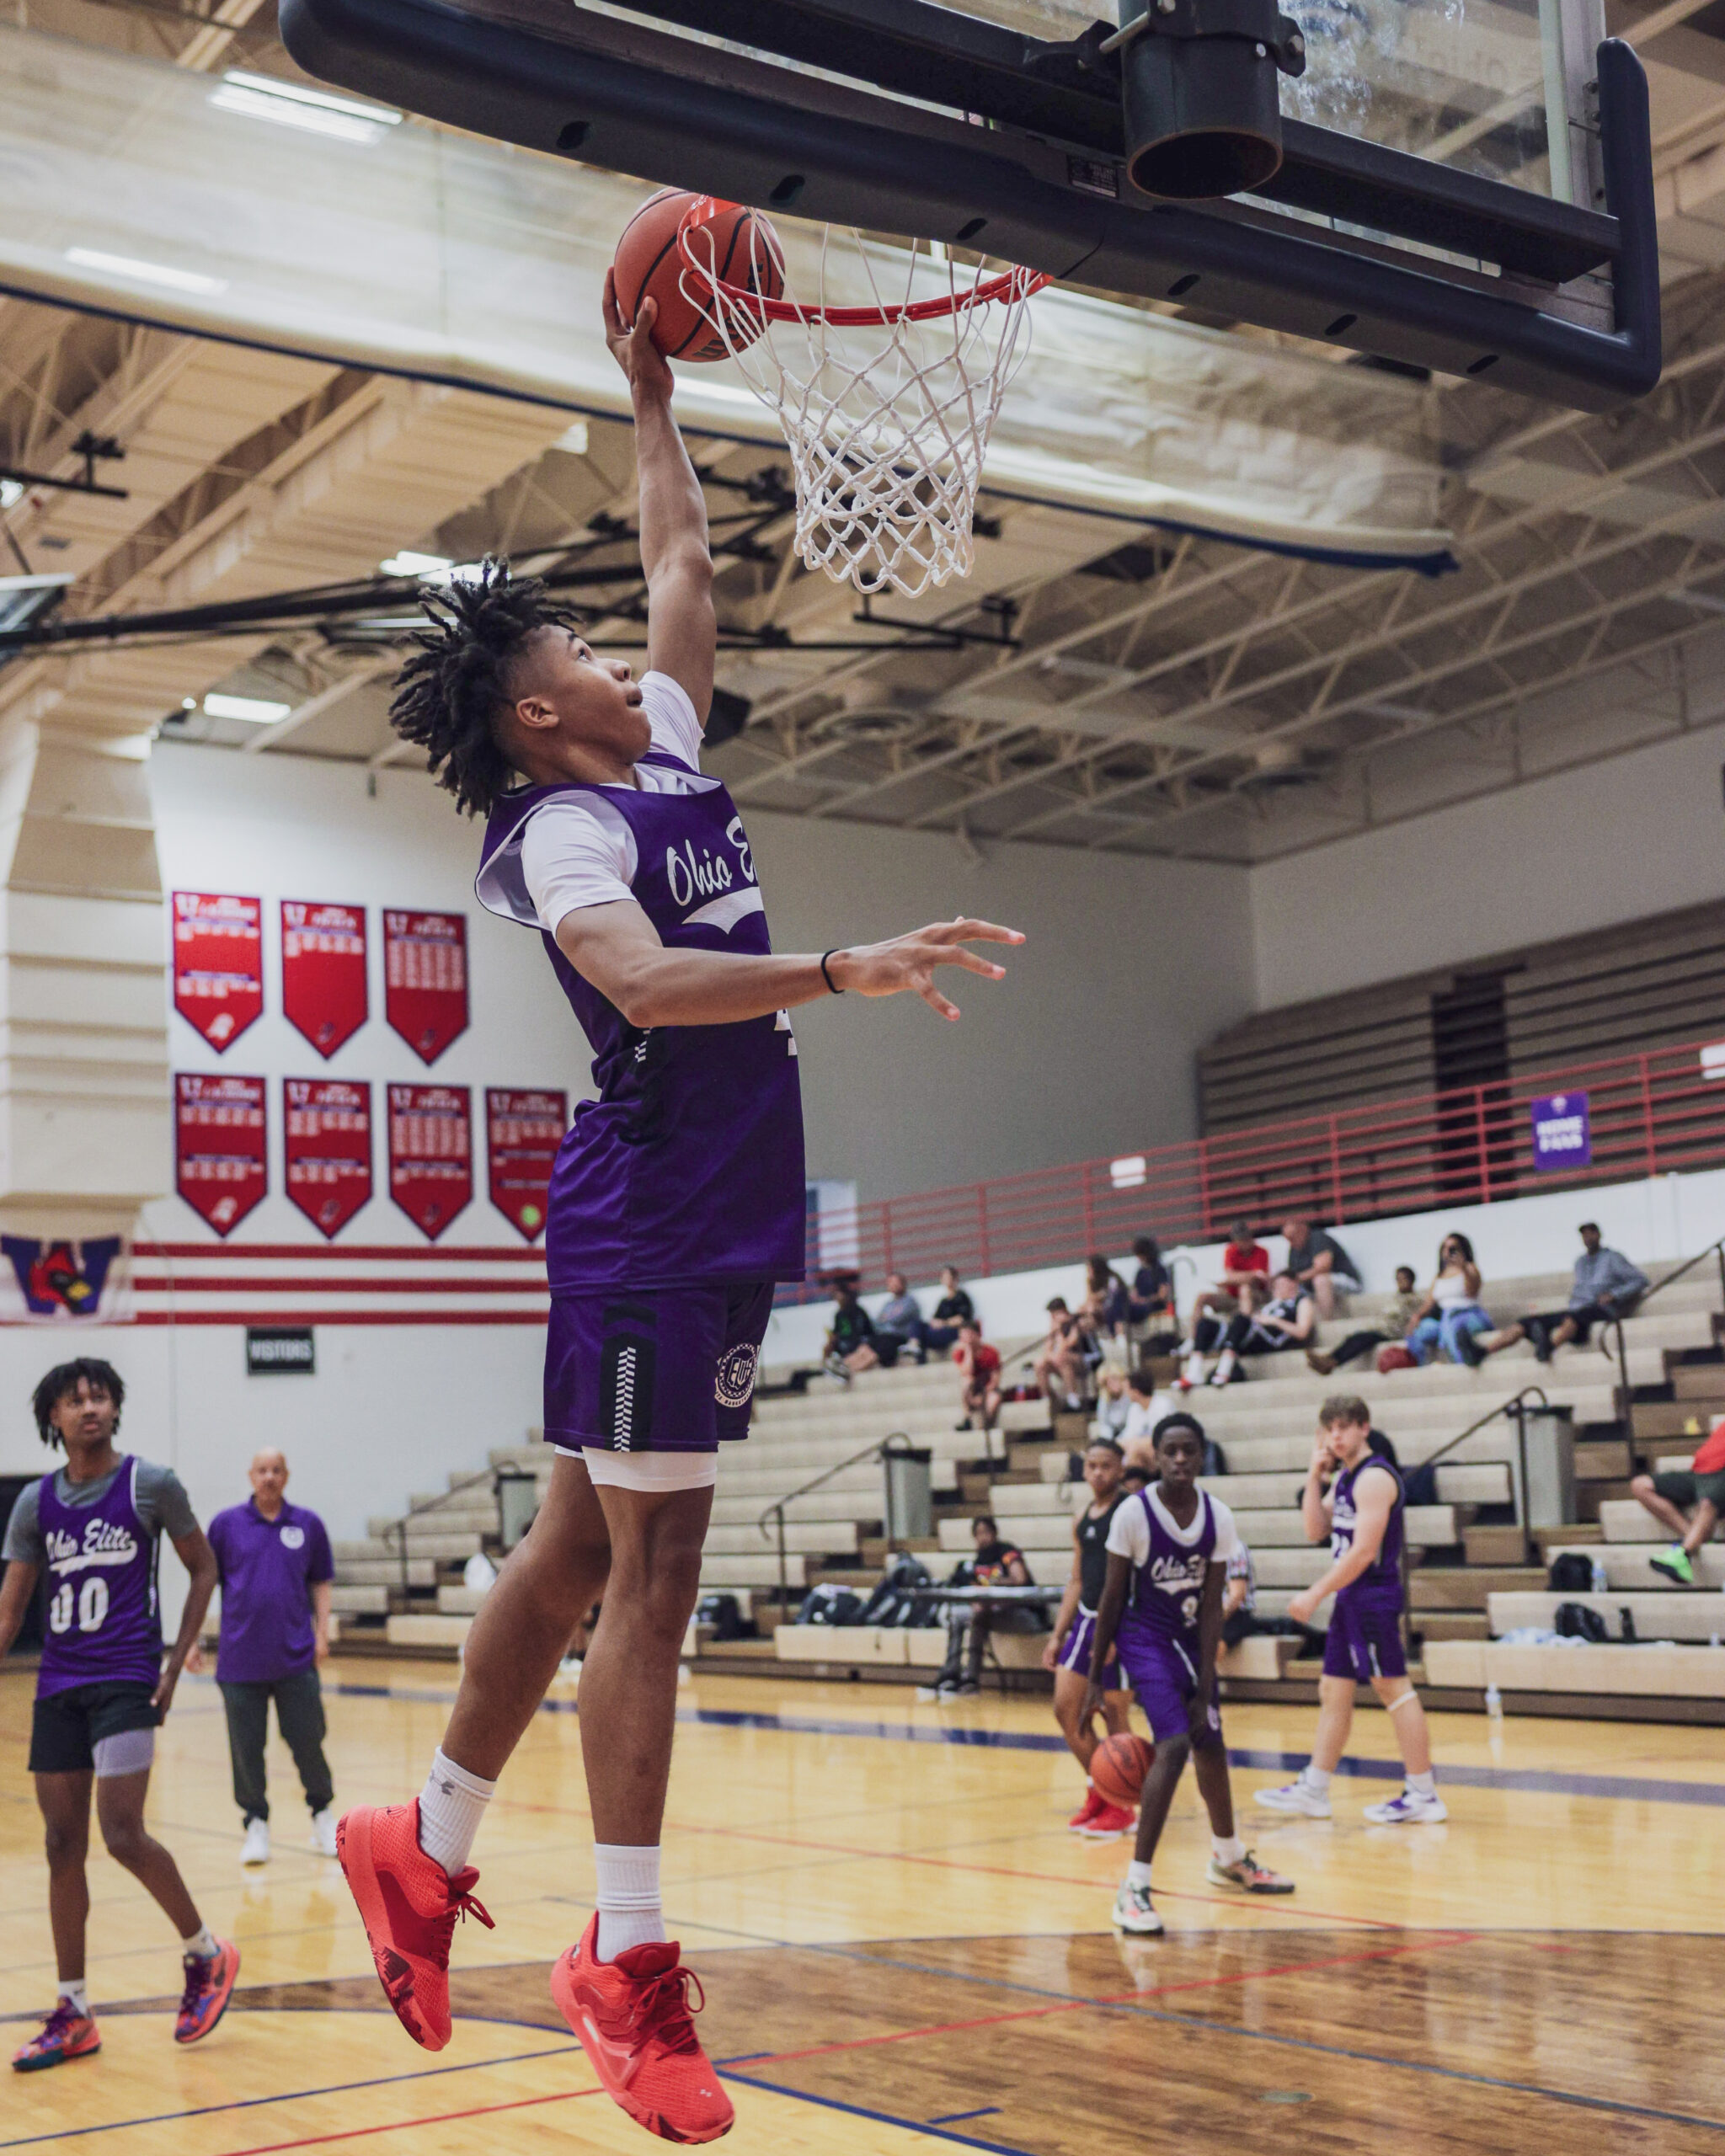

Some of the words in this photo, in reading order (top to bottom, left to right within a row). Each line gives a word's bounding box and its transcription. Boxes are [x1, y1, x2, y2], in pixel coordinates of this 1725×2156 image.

[667, 839, 733, 907] Ohio
[251, 1338, 312, 1361] VISITORS
[82, 1518, 131, 1554] Elite
